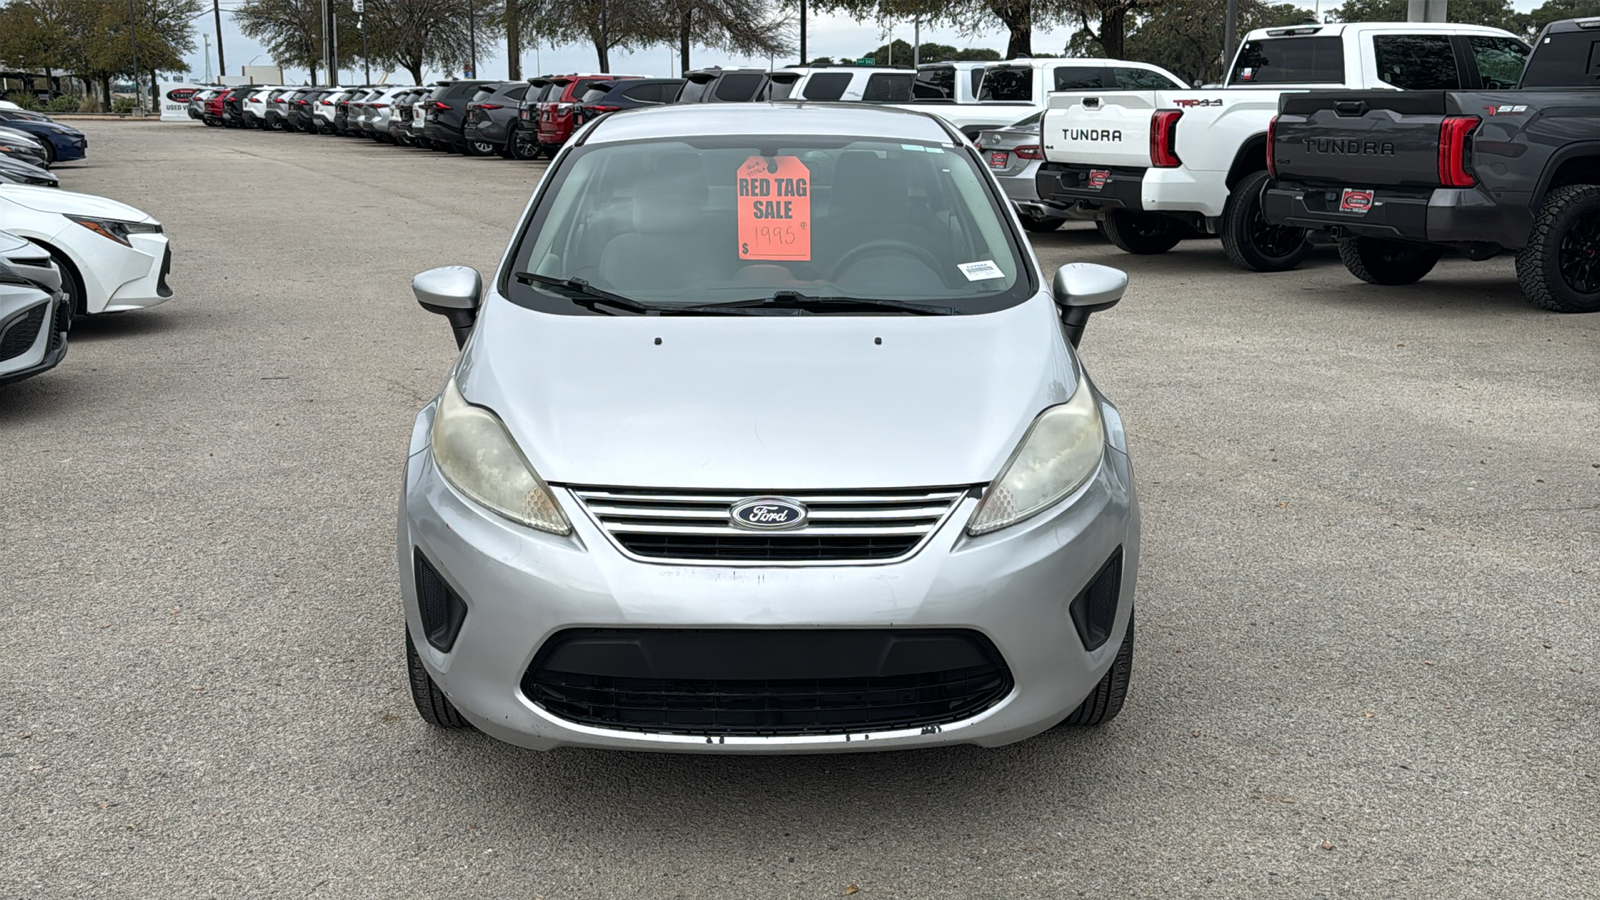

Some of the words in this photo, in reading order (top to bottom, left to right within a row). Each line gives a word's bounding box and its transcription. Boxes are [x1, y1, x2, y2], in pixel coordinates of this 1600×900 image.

[1062, 129, 1122, 142] TUNDRA
[1302, 139, 1395, 157] TUNDRA
[739, 178, 770, 197] RED
[775, 178, 807, 197] TAG
[753, 201, 793, 219] SALE
[742, 242, 749, 255] $
[754, 226, 796, 246] 1995
[749, 506, 788, 522] Ford
